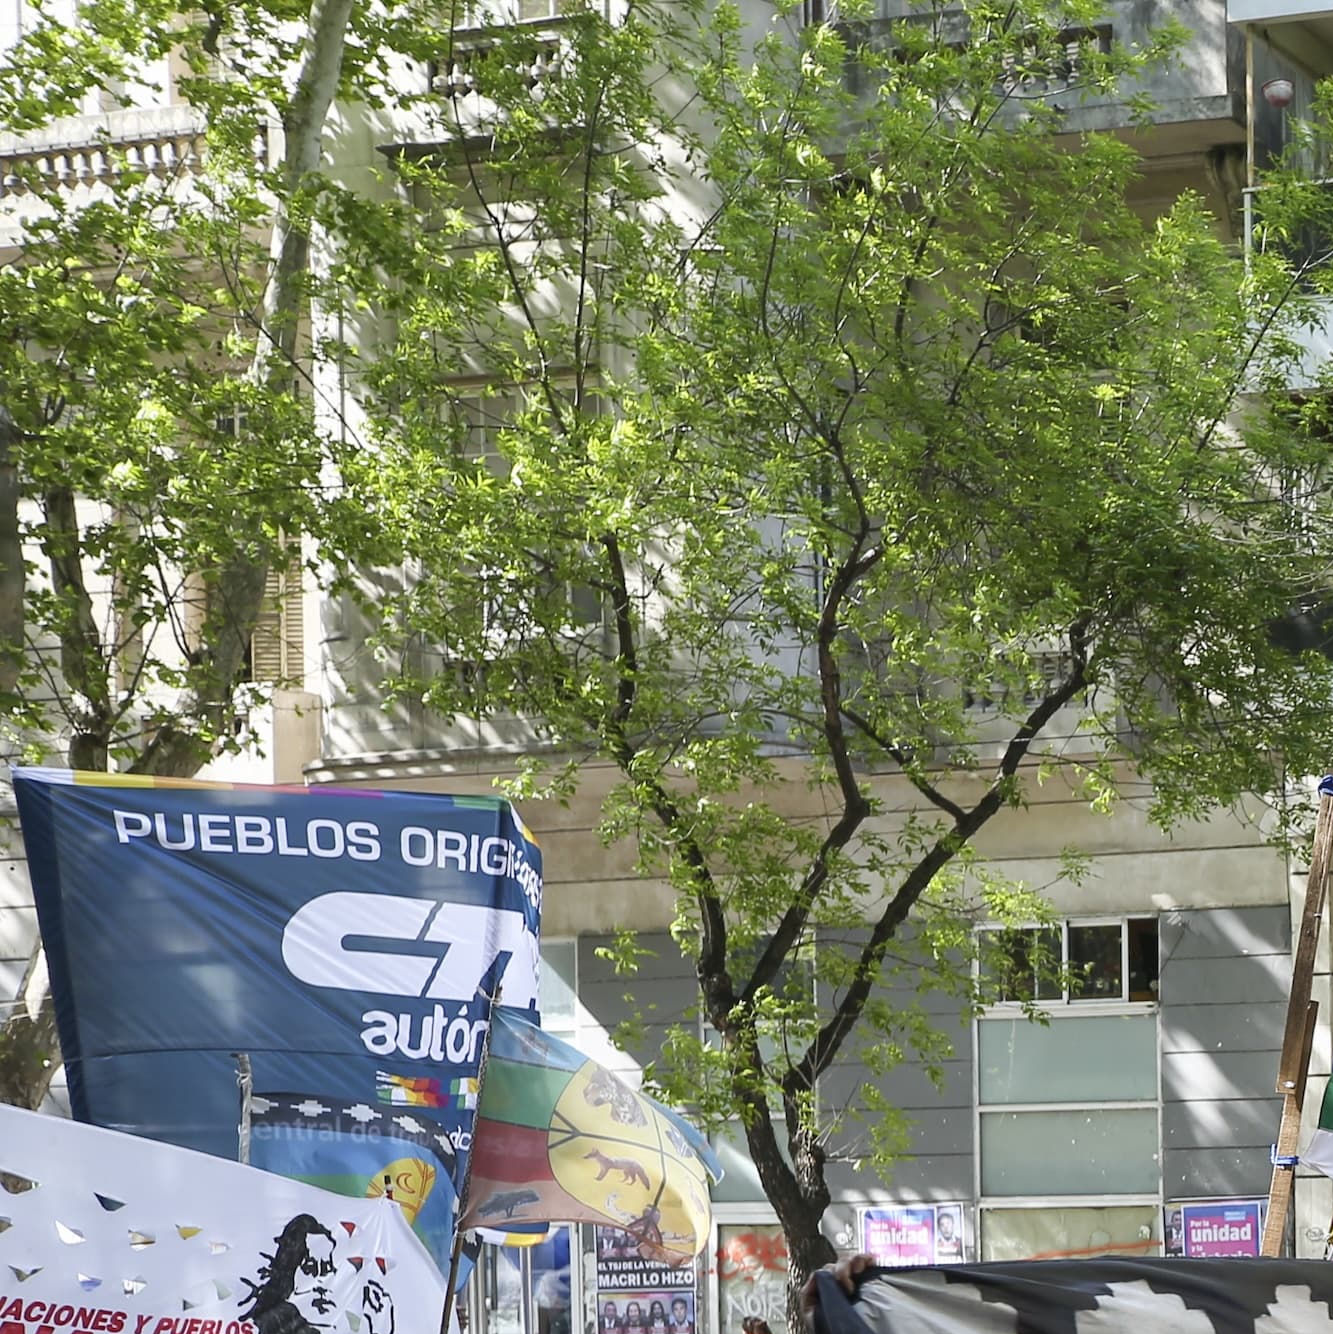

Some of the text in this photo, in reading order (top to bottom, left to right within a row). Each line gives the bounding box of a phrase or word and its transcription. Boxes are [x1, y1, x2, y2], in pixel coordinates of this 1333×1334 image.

[112, 808, 382, 862] PUEBLOS
[870, 1227, 928, 1245] unidad
[1191, 1223, 1252, 1242] unidad
[598, 1271, 694, 1288] MACRI LO HIZO
[0, 1296, 127, 1333] ACIONES
[134, 1314, 152, 1334] Y
